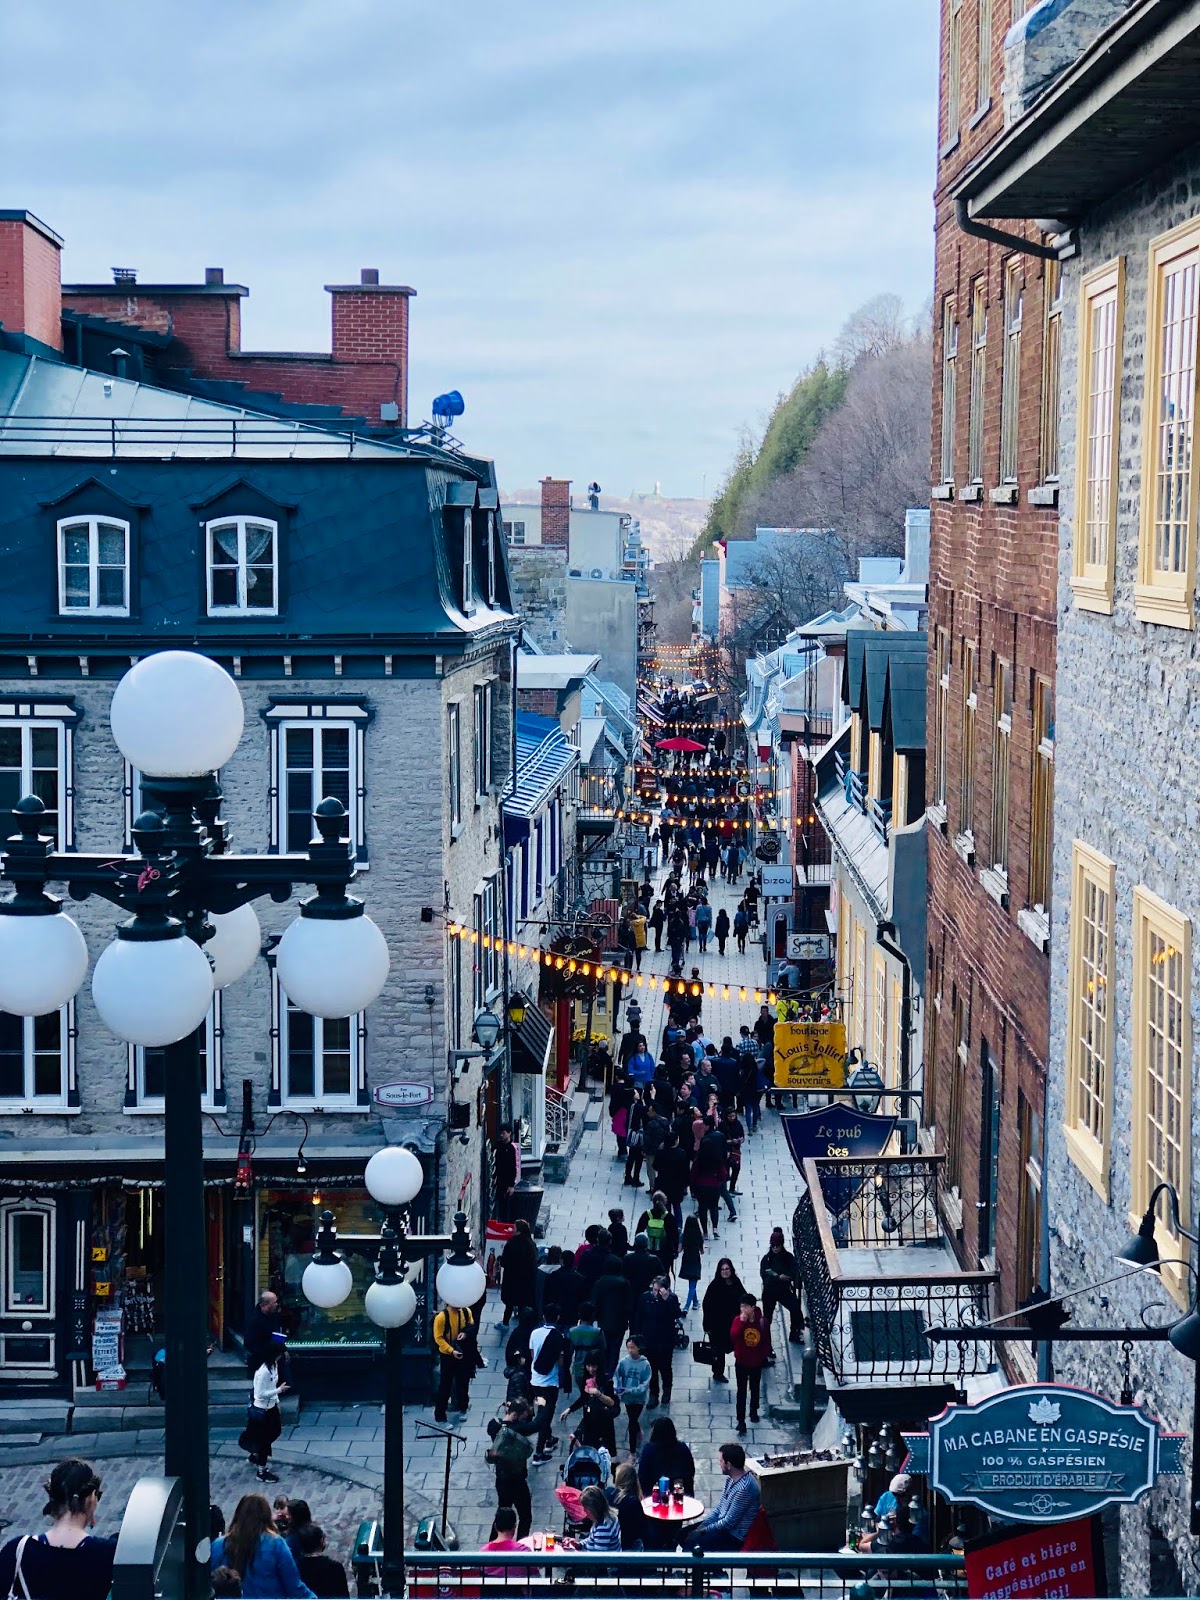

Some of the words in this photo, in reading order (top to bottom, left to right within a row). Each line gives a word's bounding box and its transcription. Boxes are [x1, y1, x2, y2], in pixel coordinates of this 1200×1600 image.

[763, 873, 791, 884] bizou
[790, 1026, 829, 1037] boutique
[776, 1043, 809, 1061] Louis
[811, 1039, 845, 1063] Jolliet
[788, 1076, 831, 1085] souvenirs
[815, 1125, 833, 1138] Le
[837, 1124, 862, 1141] pub
[827, 1143, 849, 1157] des
[944, 1435, 969, 1452] MA
[971, 1428, 1037, 1447] CABANE
[1041, 1428, 1061, 1442] EN
[1064, 1428, 1145, 1452] GASPÉSIE
[982, 1456, 1004, 1466] 100
[1007, 1456, 1023, 1466] %
[1027, 1454, 1106, 1466] GASPÉSIEN
[992, 1474, 1042, 1486] PRODUIT
[1044, 1473, 1096, 1486] D'ÉRABLE
[985, 1558, 1016, 1581] Café
[1021, 1552, 1037, 1567] et
[1040, 1541, 1077, 1560] bière
[1070, 1559, 1087, 1573] en
